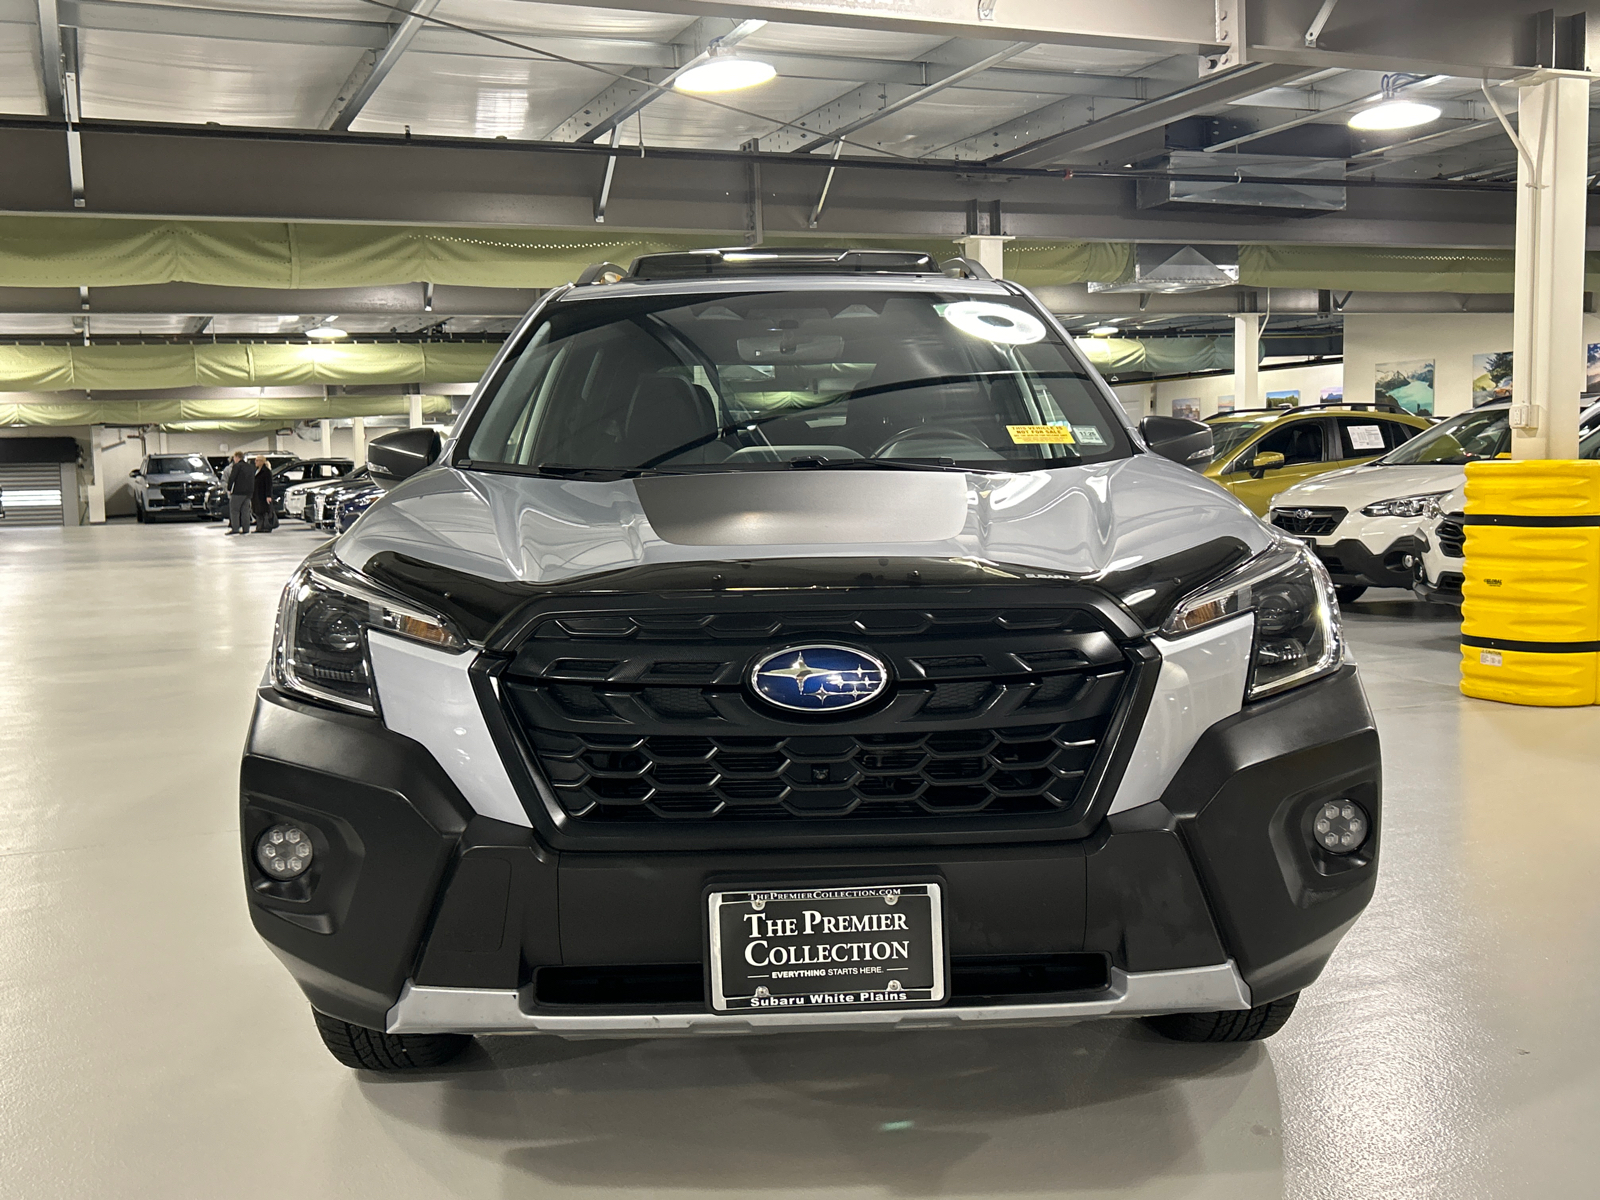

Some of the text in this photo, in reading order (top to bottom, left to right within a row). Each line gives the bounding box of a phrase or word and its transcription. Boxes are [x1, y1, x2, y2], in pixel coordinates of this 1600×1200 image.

[771, 966, 884, 979] EVERYTHING STARTS HERE.
[750, 991, 907, 1007] Subaru White Plains
